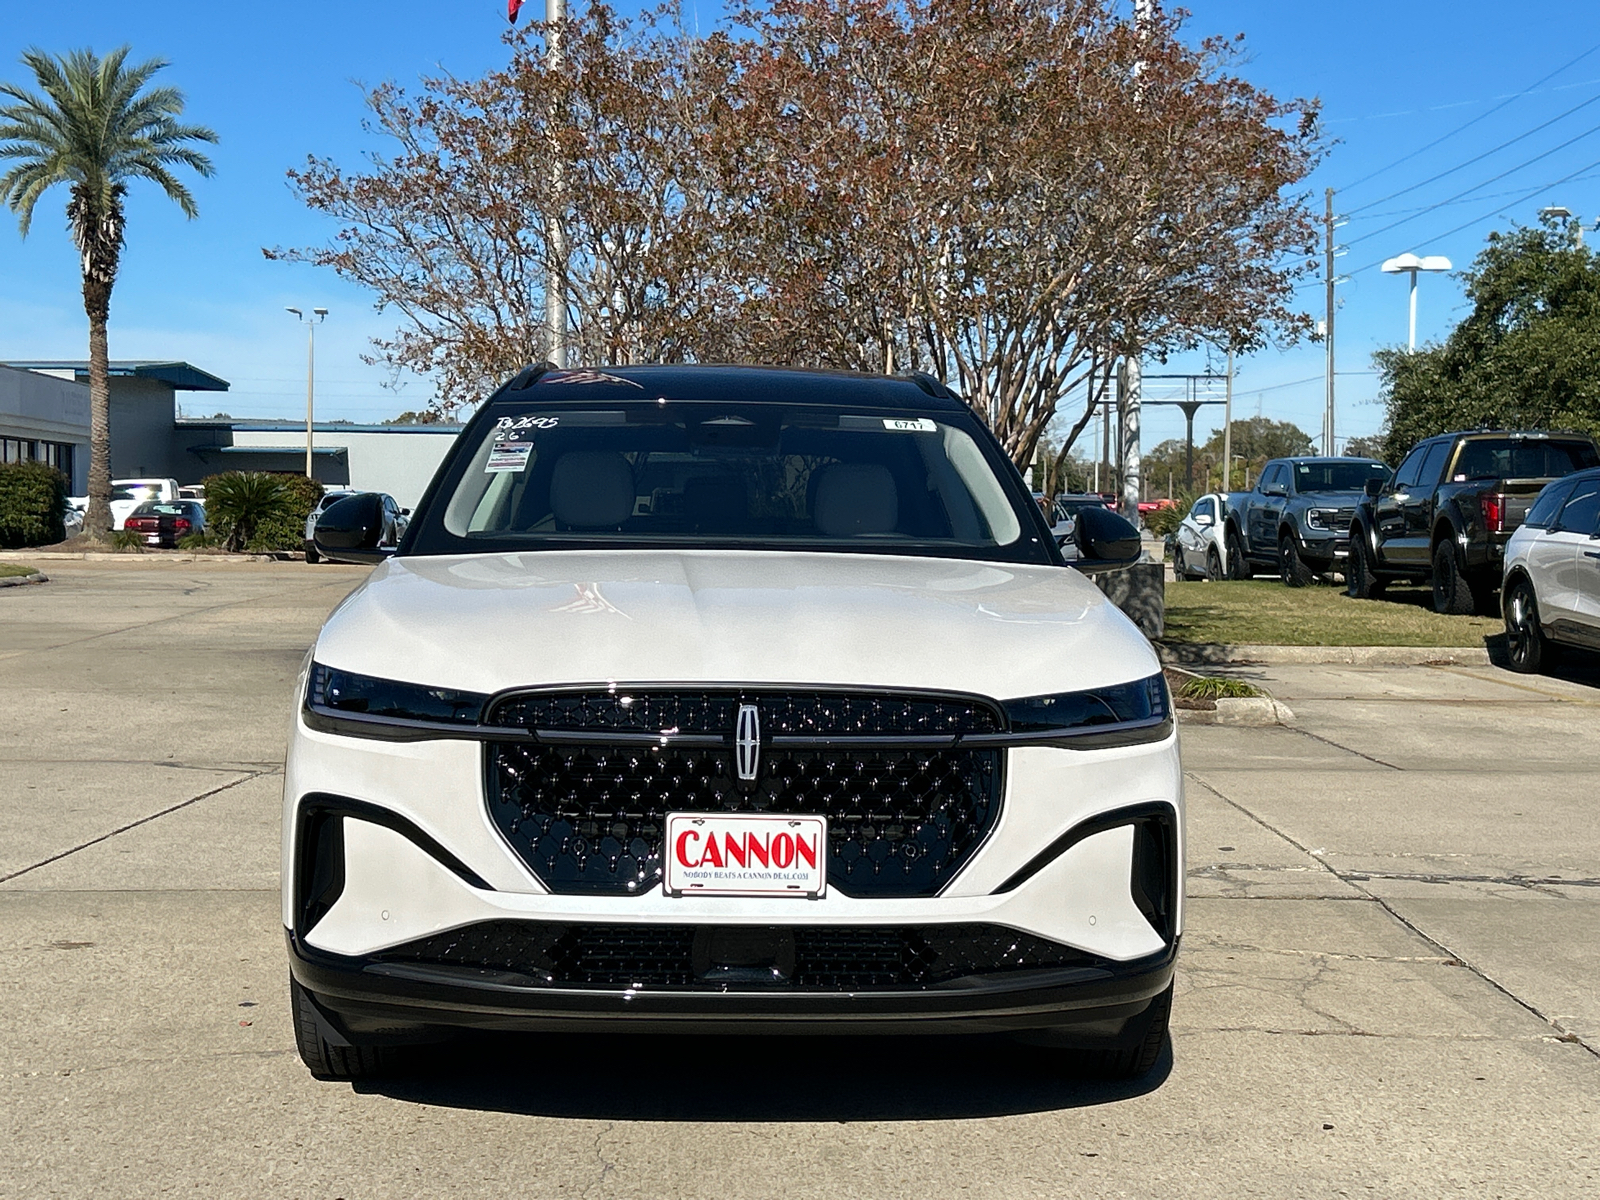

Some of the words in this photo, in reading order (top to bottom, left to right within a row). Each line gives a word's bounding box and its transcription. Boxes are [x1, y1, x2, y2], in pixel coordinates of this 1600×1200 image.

[676, 830, 817, 869] CANNON
[683, 871, 712, 879] NOBODY
[743, 872, 772, 880] CANNON
